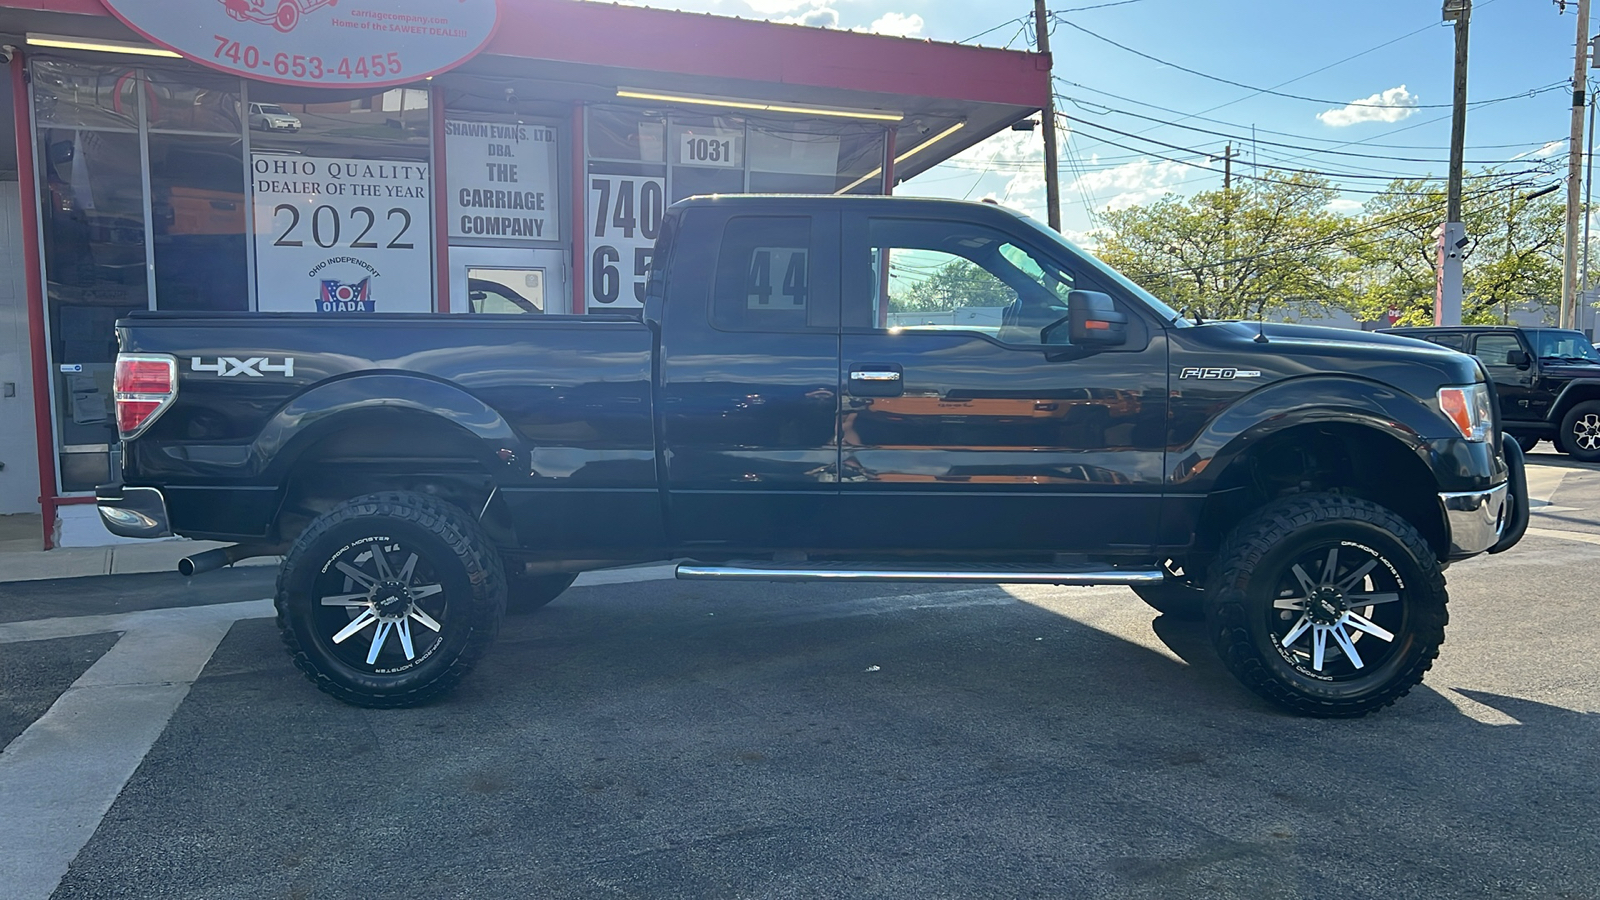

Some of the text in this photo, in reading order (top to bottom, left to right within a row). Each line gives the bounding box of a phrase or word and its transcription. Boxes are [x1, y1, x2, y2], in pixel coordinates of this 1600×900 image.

[351, 9, 448, 25] carriagecompany.com
[331, 18, 468, 38] Home of the SAWEET DEALS!!!
[212, 34, 402, 80] 740-653-4455
[445, 121, 488, 138] SHAWN
[533, 128, 556, 143] LTD.
[488, 143, 515, 158] DBA.
[687, 138, 730, 162] 1031
[254, 159, 427, 180] OHIO QUALITY
[486, 162, 518, 183] THE
[258, 180, 426, 199] DEALER OF THE YEAR
[459, 187, 545, 211] CARRIAGE
[591, 178, 663, 240] 740
[273, 203, 414, 250] 2022
[460, 215, 545, 238] COMPANY
[308, 256, 381, 278] OHIO INDEPENDENT
[322, 301, 366, 312] OIADA
[191, 356, 294, 377] 4X4
[351, 536, 390, 547] MONSTER
[1379, 556, 1405, 589] MONSTER
